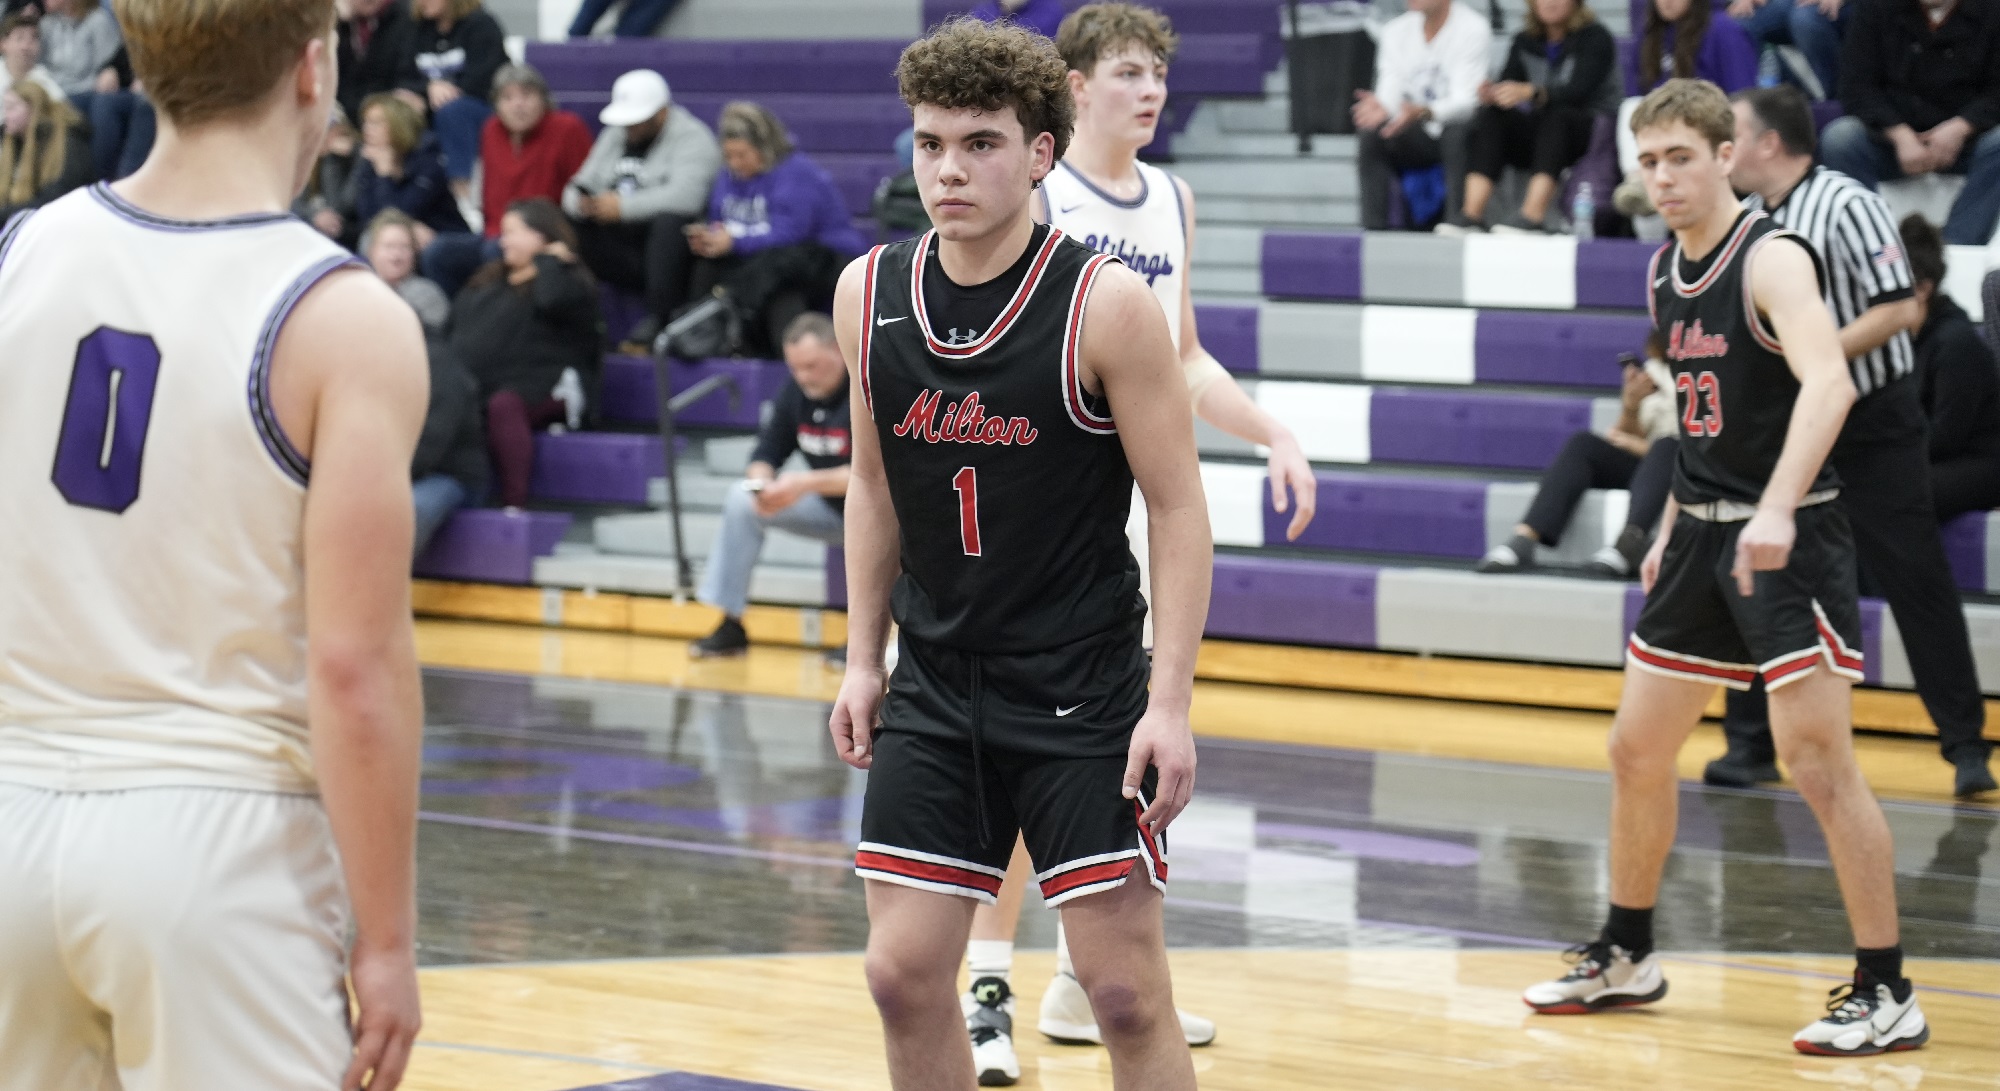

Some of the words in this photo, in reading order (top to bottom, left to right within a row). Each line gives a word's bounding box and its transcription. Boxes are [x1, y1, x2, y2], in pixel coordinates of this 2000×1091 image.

[1085, 234, 1173, 287] kings
[1666, 318, 1729, 361] Milton
[50, 324, 162, 515] 0
[893, 388, 1038, 446] Milton
[1676, 371, 1723, 437] 23
[952, 466, 982, 557] 1
